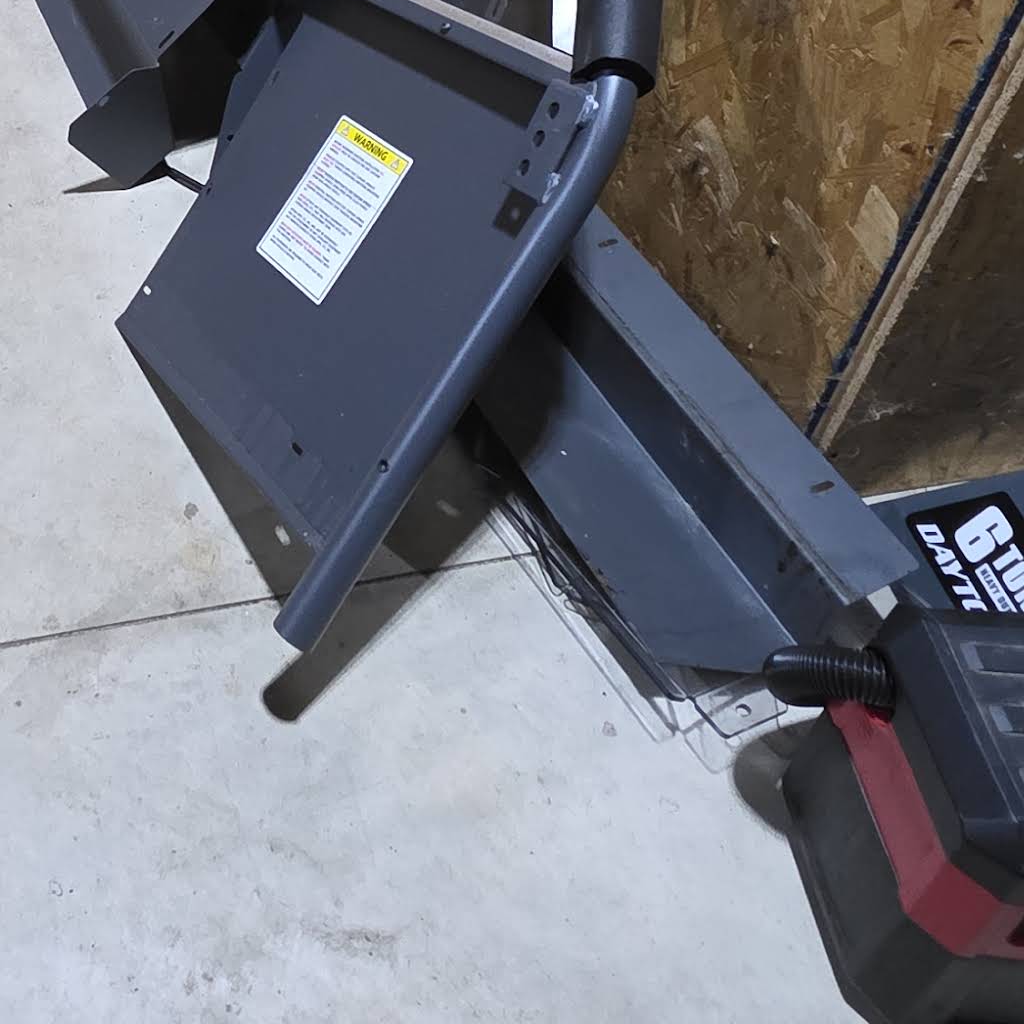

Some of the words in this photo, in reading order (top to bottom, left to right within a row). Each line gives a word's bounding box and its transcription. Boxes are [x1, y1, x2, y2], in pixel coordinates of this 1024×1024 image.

[353, 132, 389, 162] WARNING
[954, 505, 1014, 564] 6
[979, 568, 1001, 598] HEAVY
